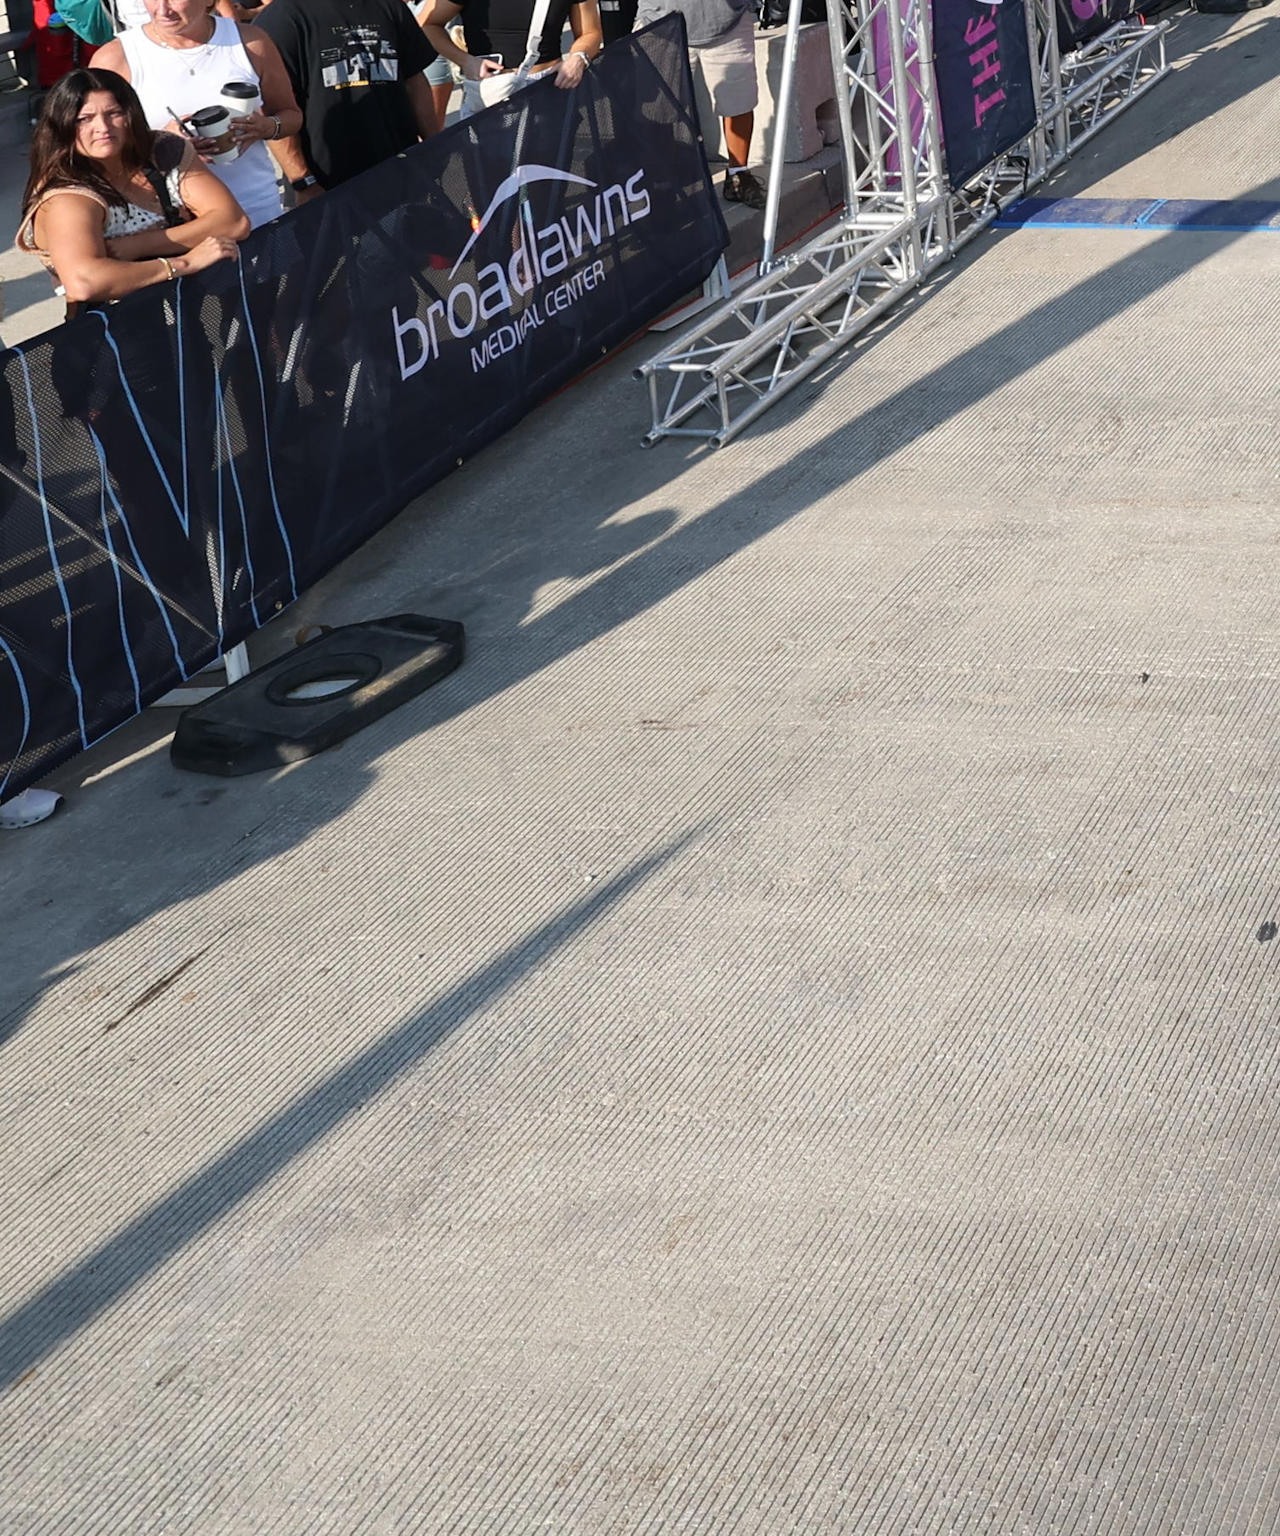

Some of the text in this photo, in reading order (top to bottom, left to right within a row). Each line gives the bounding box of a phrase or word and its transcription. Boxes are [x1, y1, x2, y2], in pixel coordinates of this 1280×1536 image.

[963, 5, 1007, 128] THE
[391, 168, 651, 382] broadlawns
[469, 259, 606, 373] MEDICAL CENTER
